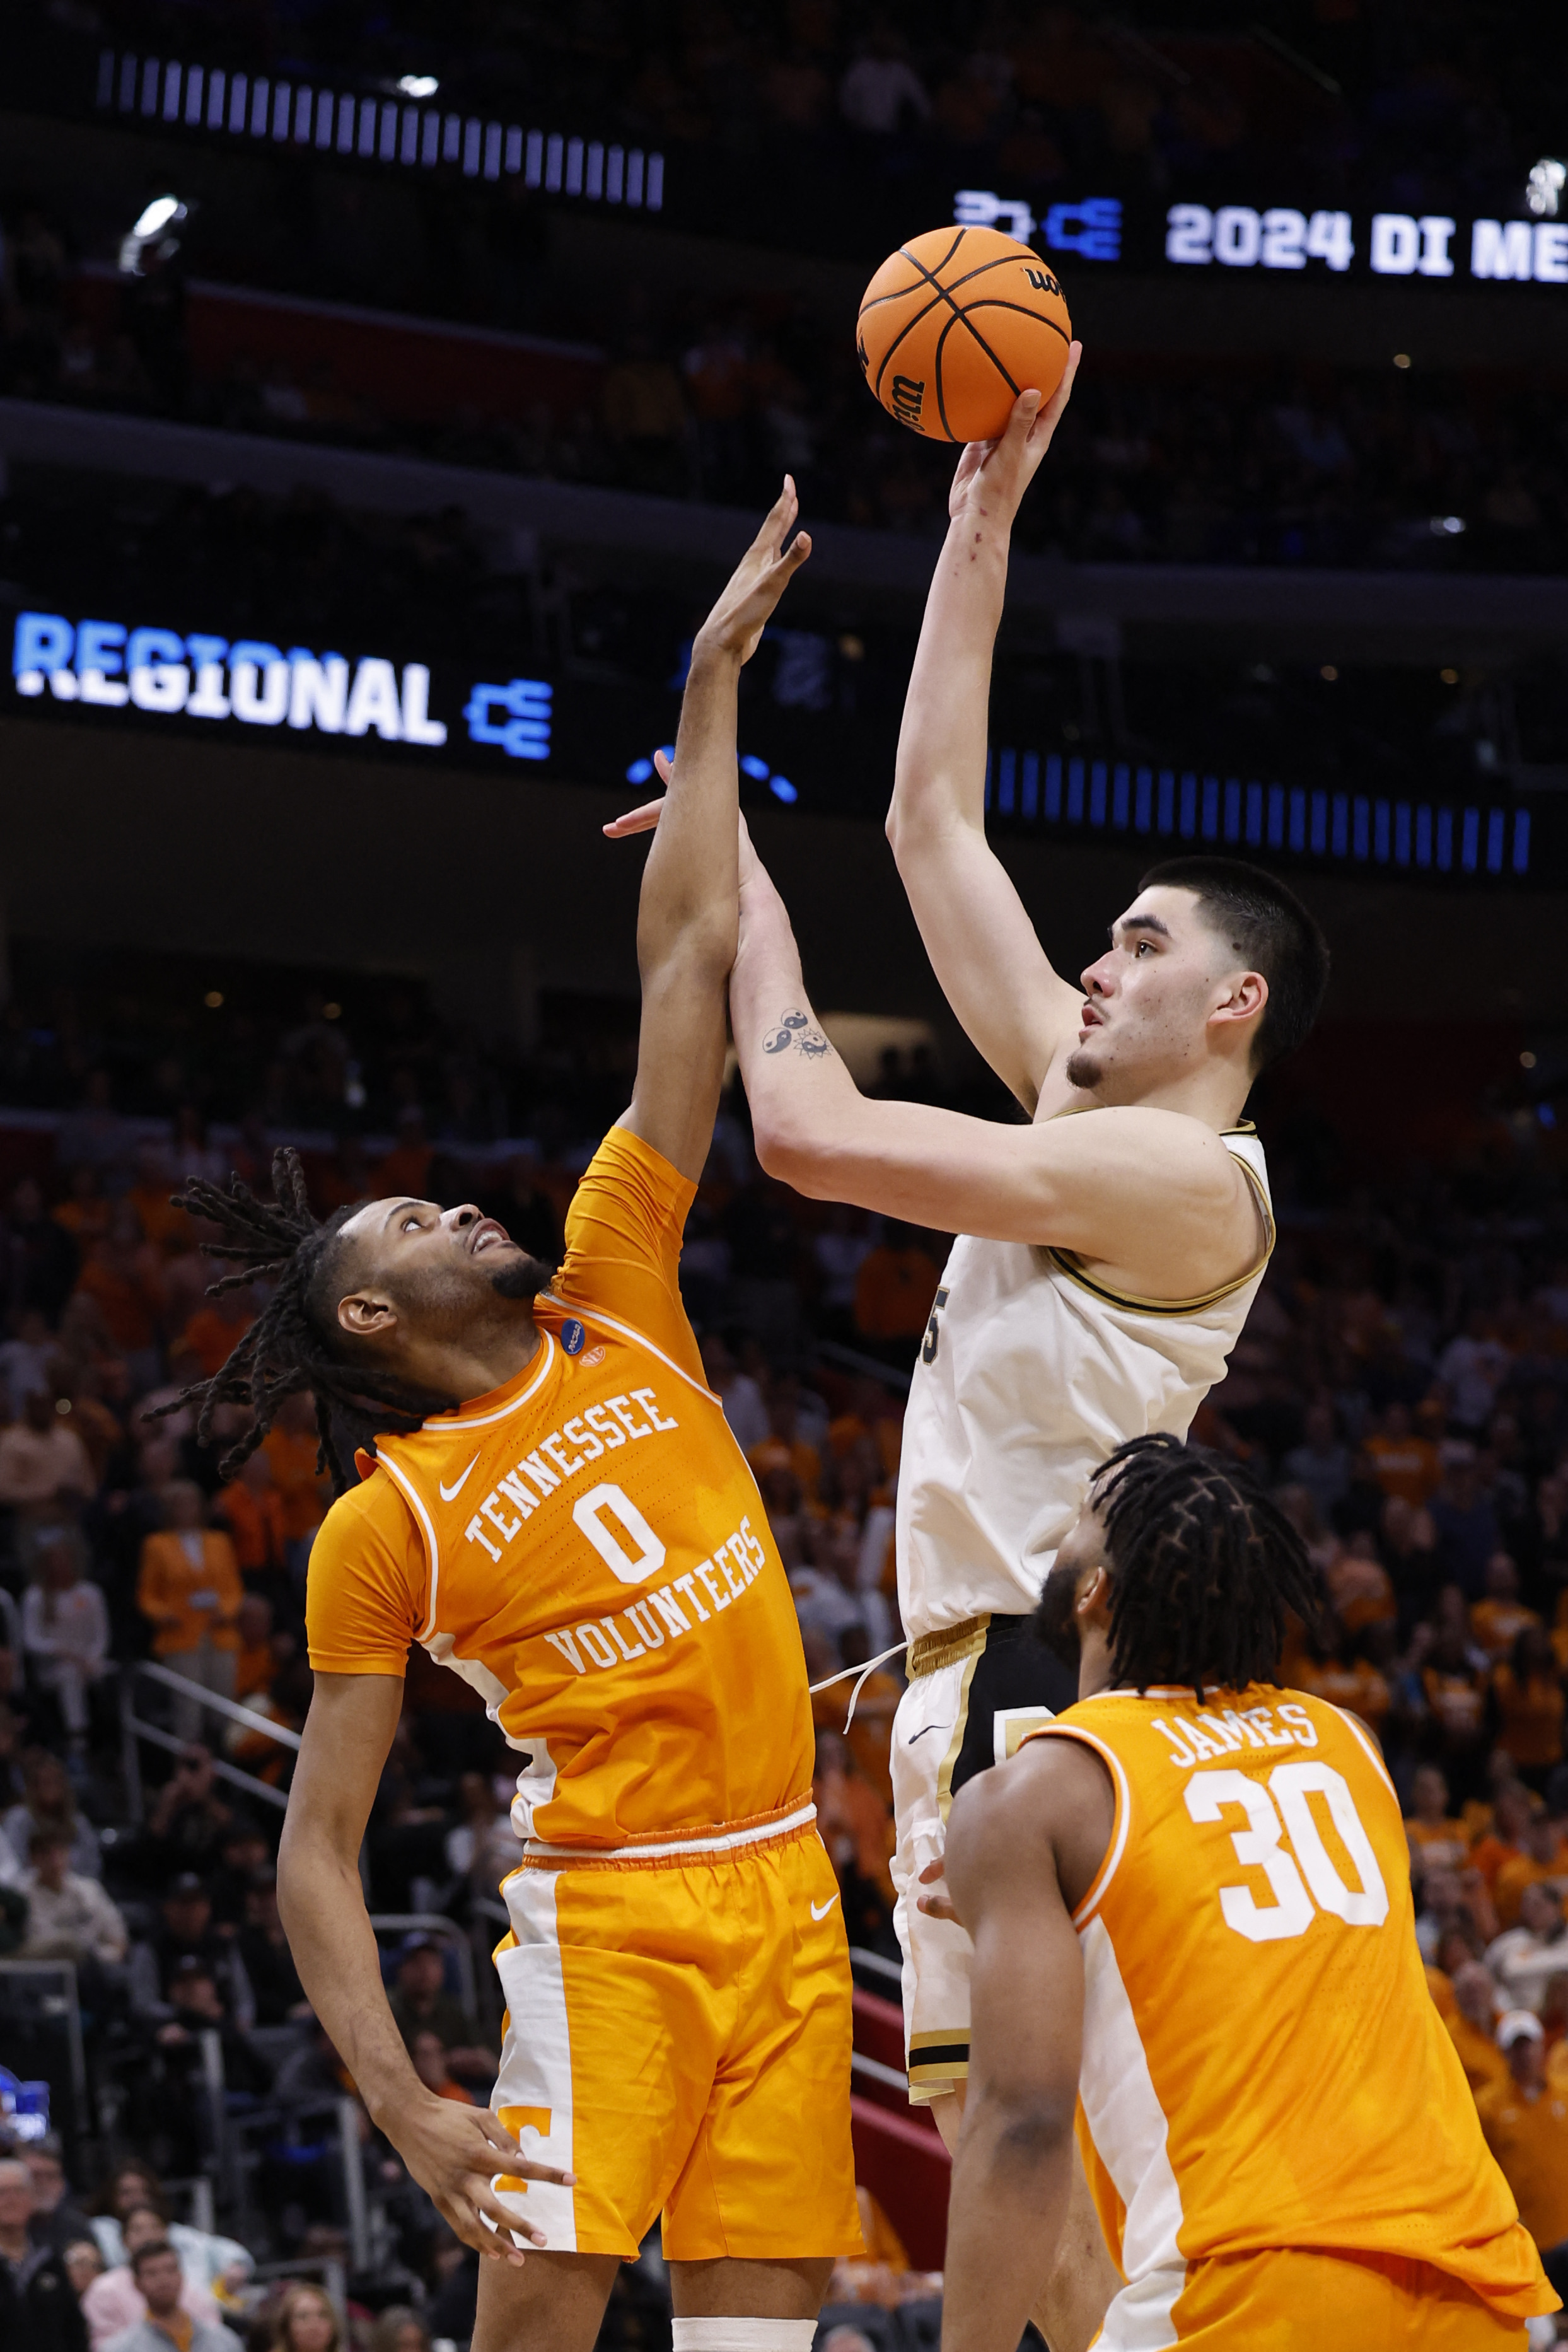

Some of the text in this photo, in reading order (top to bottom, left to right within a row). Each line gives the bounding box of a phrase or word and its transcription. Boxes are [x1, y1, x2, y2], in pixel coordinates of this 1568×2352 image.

[1166, 204, 1354, 272] 2024
[1371, 214, 1455, 276] DI
[13, 612, 447, 745] REGIONAL
[581, 1347, 603, 1365] SEC
[465, 1387, 678, 1563] TENNESSEE
[572, 1482, 666, 1584] 0
[543, 1515, 766, 1674] VOLUNTEERS
[1151, 1704, 1318, 1767] JAMES
[1183, 1761, 1389, 1942] 30
